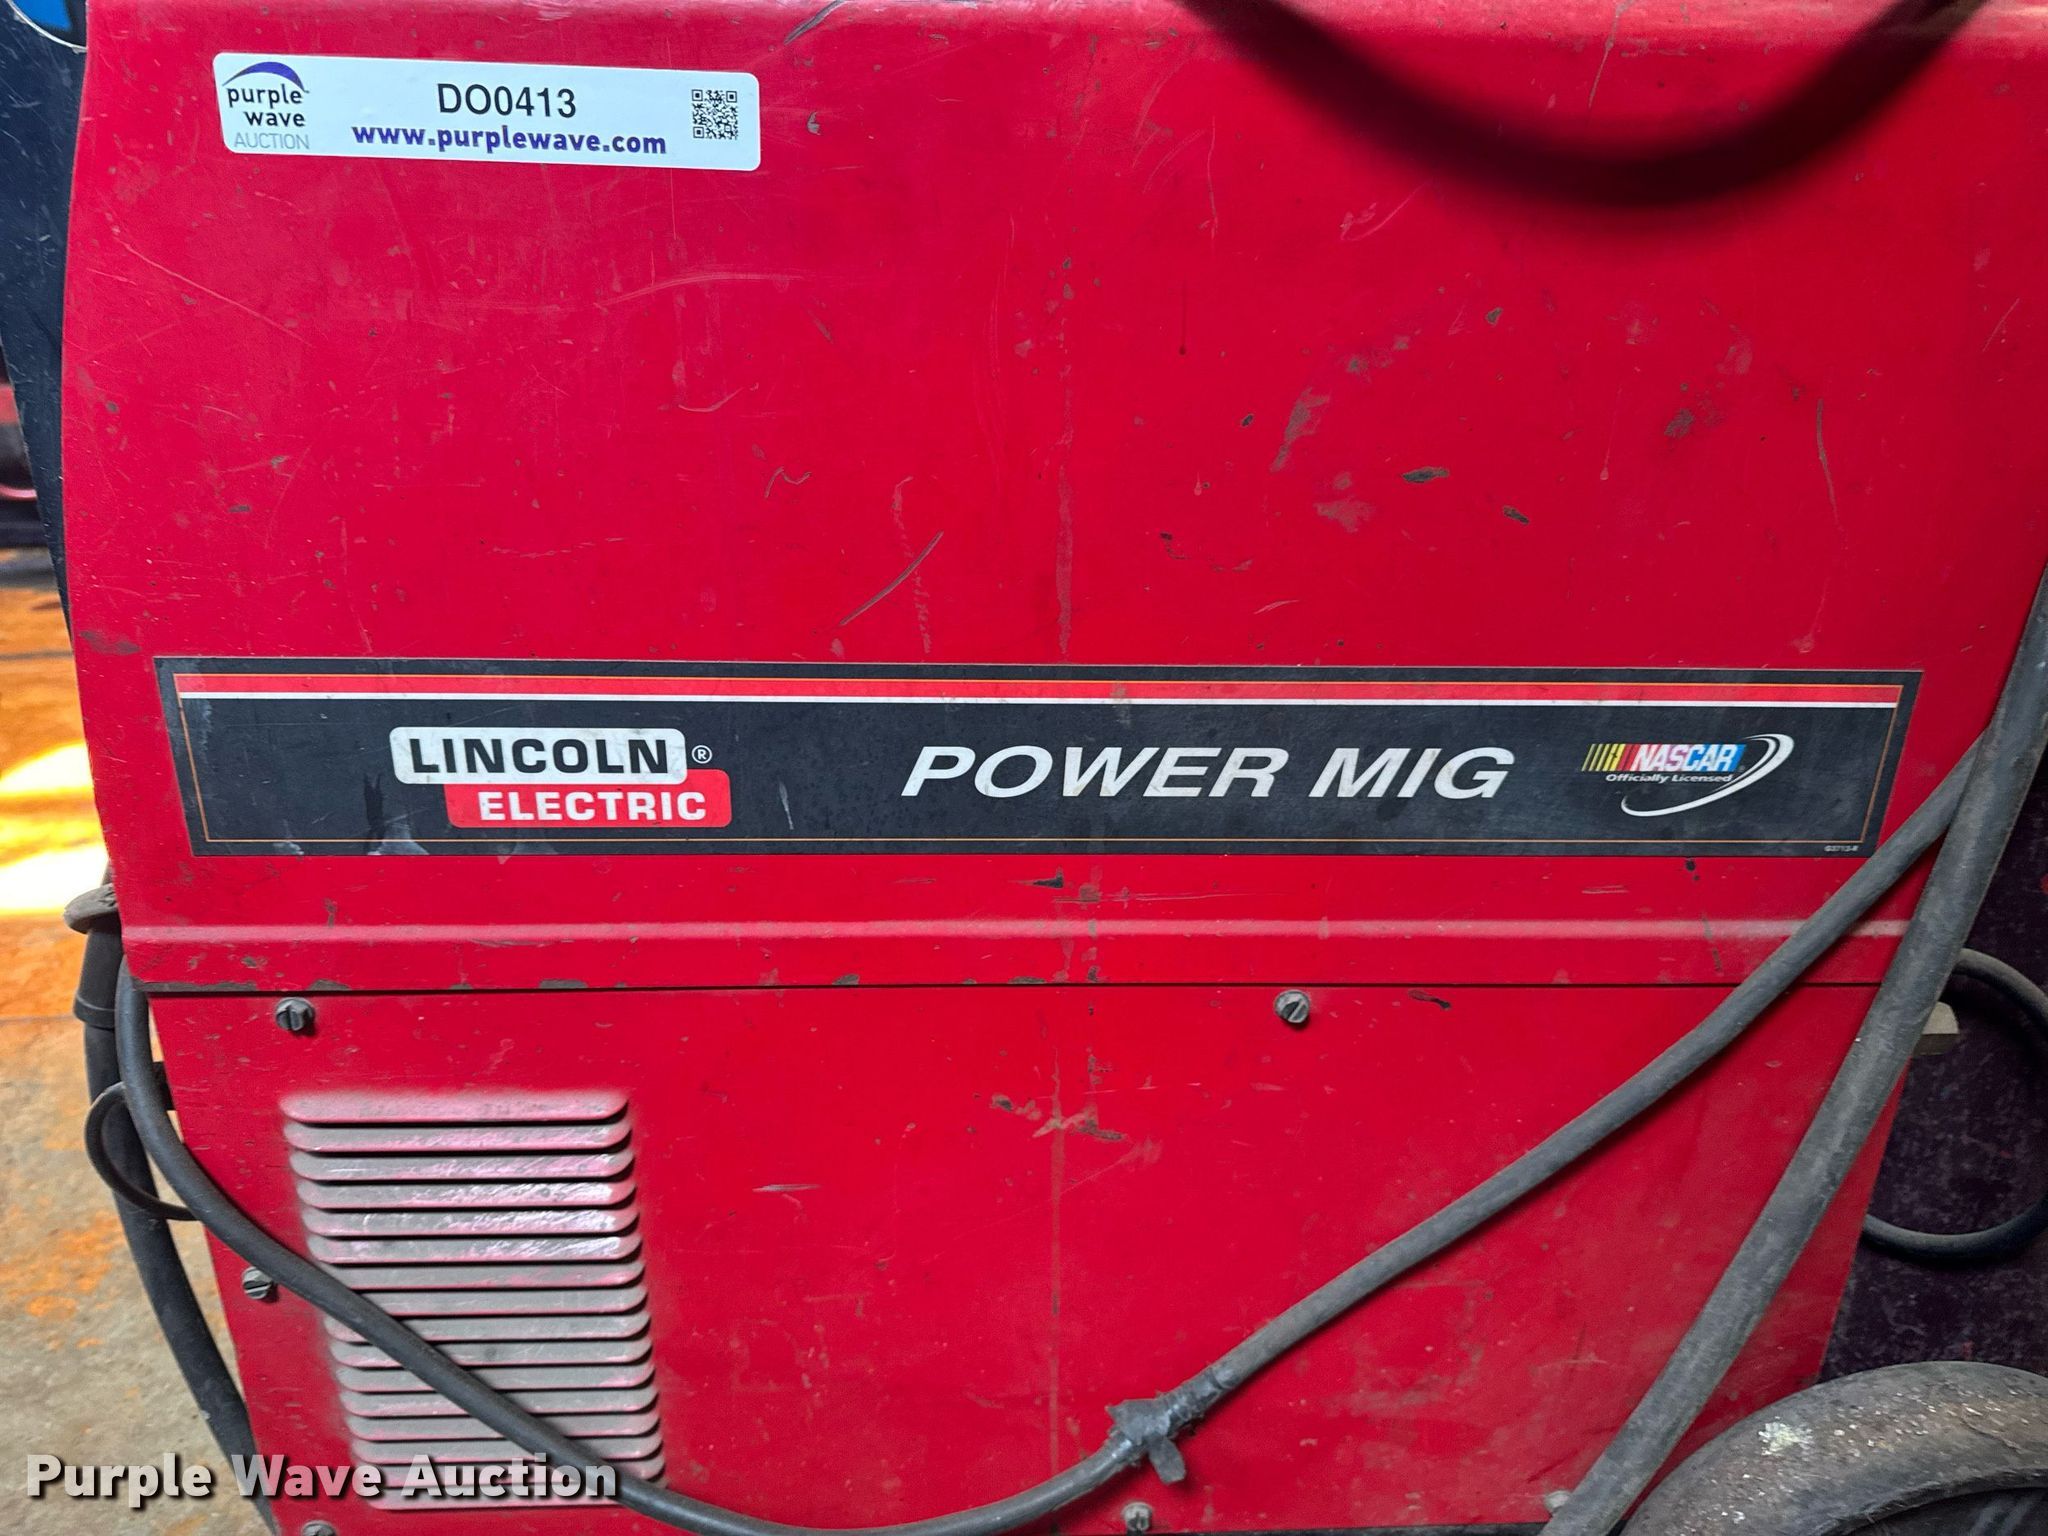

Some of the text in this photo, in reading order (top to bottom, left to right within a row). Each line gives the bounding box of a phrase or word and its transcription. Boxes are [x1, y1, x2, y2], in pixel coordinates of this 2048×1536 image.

[227, 86, 304, 107] purple
[245, 110, 306, 128] wave
[234, 132, 310, 150] AUCTION
[352, 125, 668, 155] www.purplewave.com
[409, 738, 669, 774] LINCOLN
[1630, 744, 1739, 771] NASCAR
[900, 745, 1515, 799] POWER MIG
[1605, 773, 1733, 783] Officially Licensed
[477, 791, 706, 821] ELECTRIC
